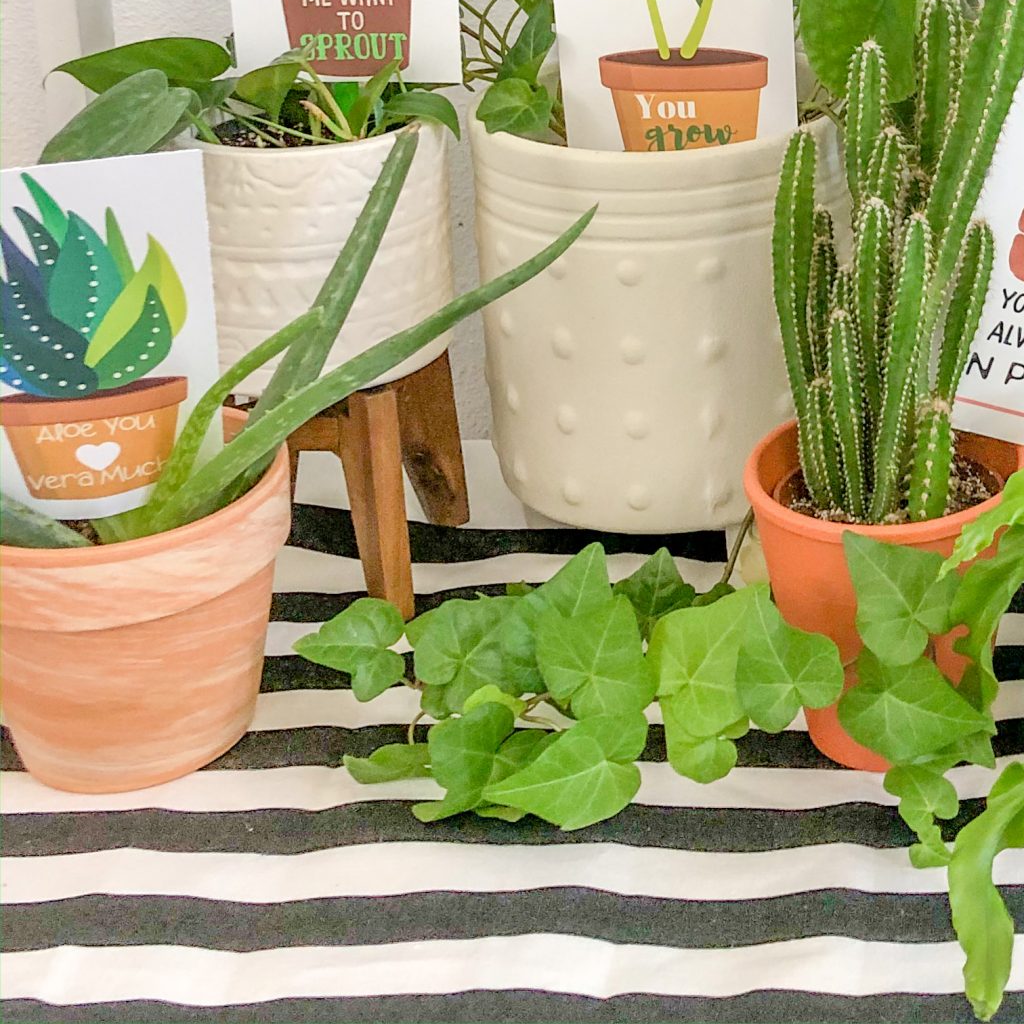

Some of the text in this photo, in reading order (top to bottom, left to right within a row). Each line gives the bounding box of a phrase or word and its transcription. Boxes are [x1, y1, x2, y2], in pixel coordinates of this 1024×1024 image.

[336, 10, 365, 31] TO
[300, 32, 408, 61] SPROUT
[634, 93, 697, 120] You
[644, 123, 738, 152] grow
[35, 422, 97, 444] Aloe
